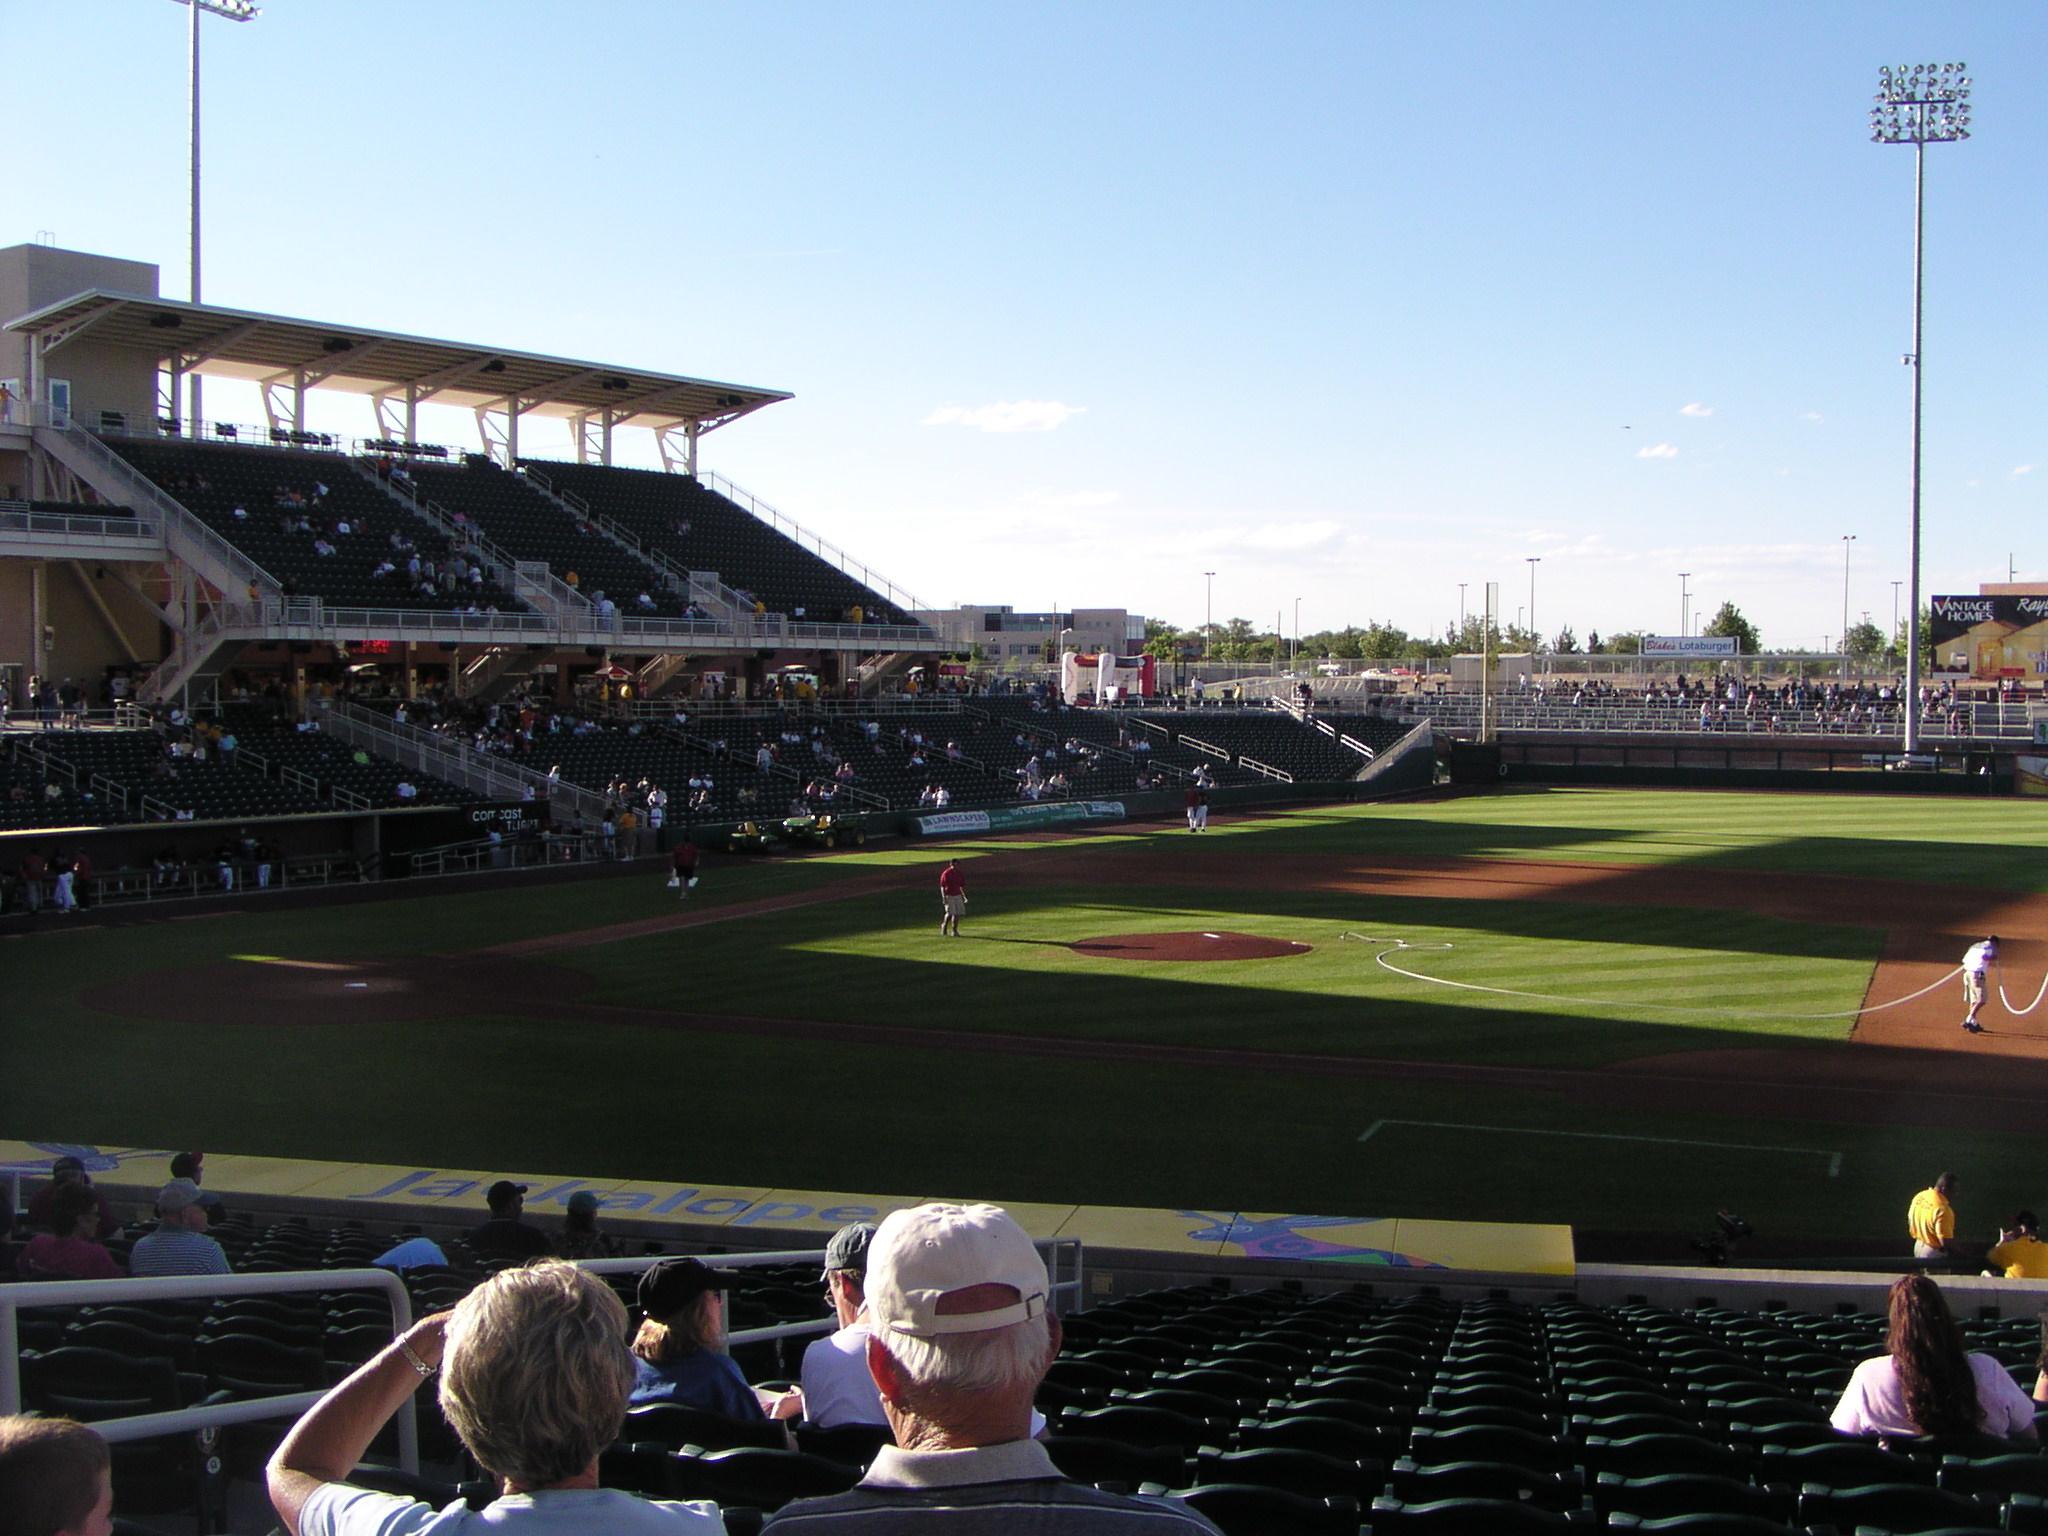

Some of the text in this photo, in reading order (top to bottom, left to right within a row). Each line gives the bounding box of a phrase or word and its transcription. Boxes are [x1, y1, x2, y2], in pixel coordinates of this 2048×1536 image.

[1934, 596, 1993, 616] VANTAGE
[1947, 611, 1993, 621] HOMES
[1679, 641, 1732, 651] Lotaburger
